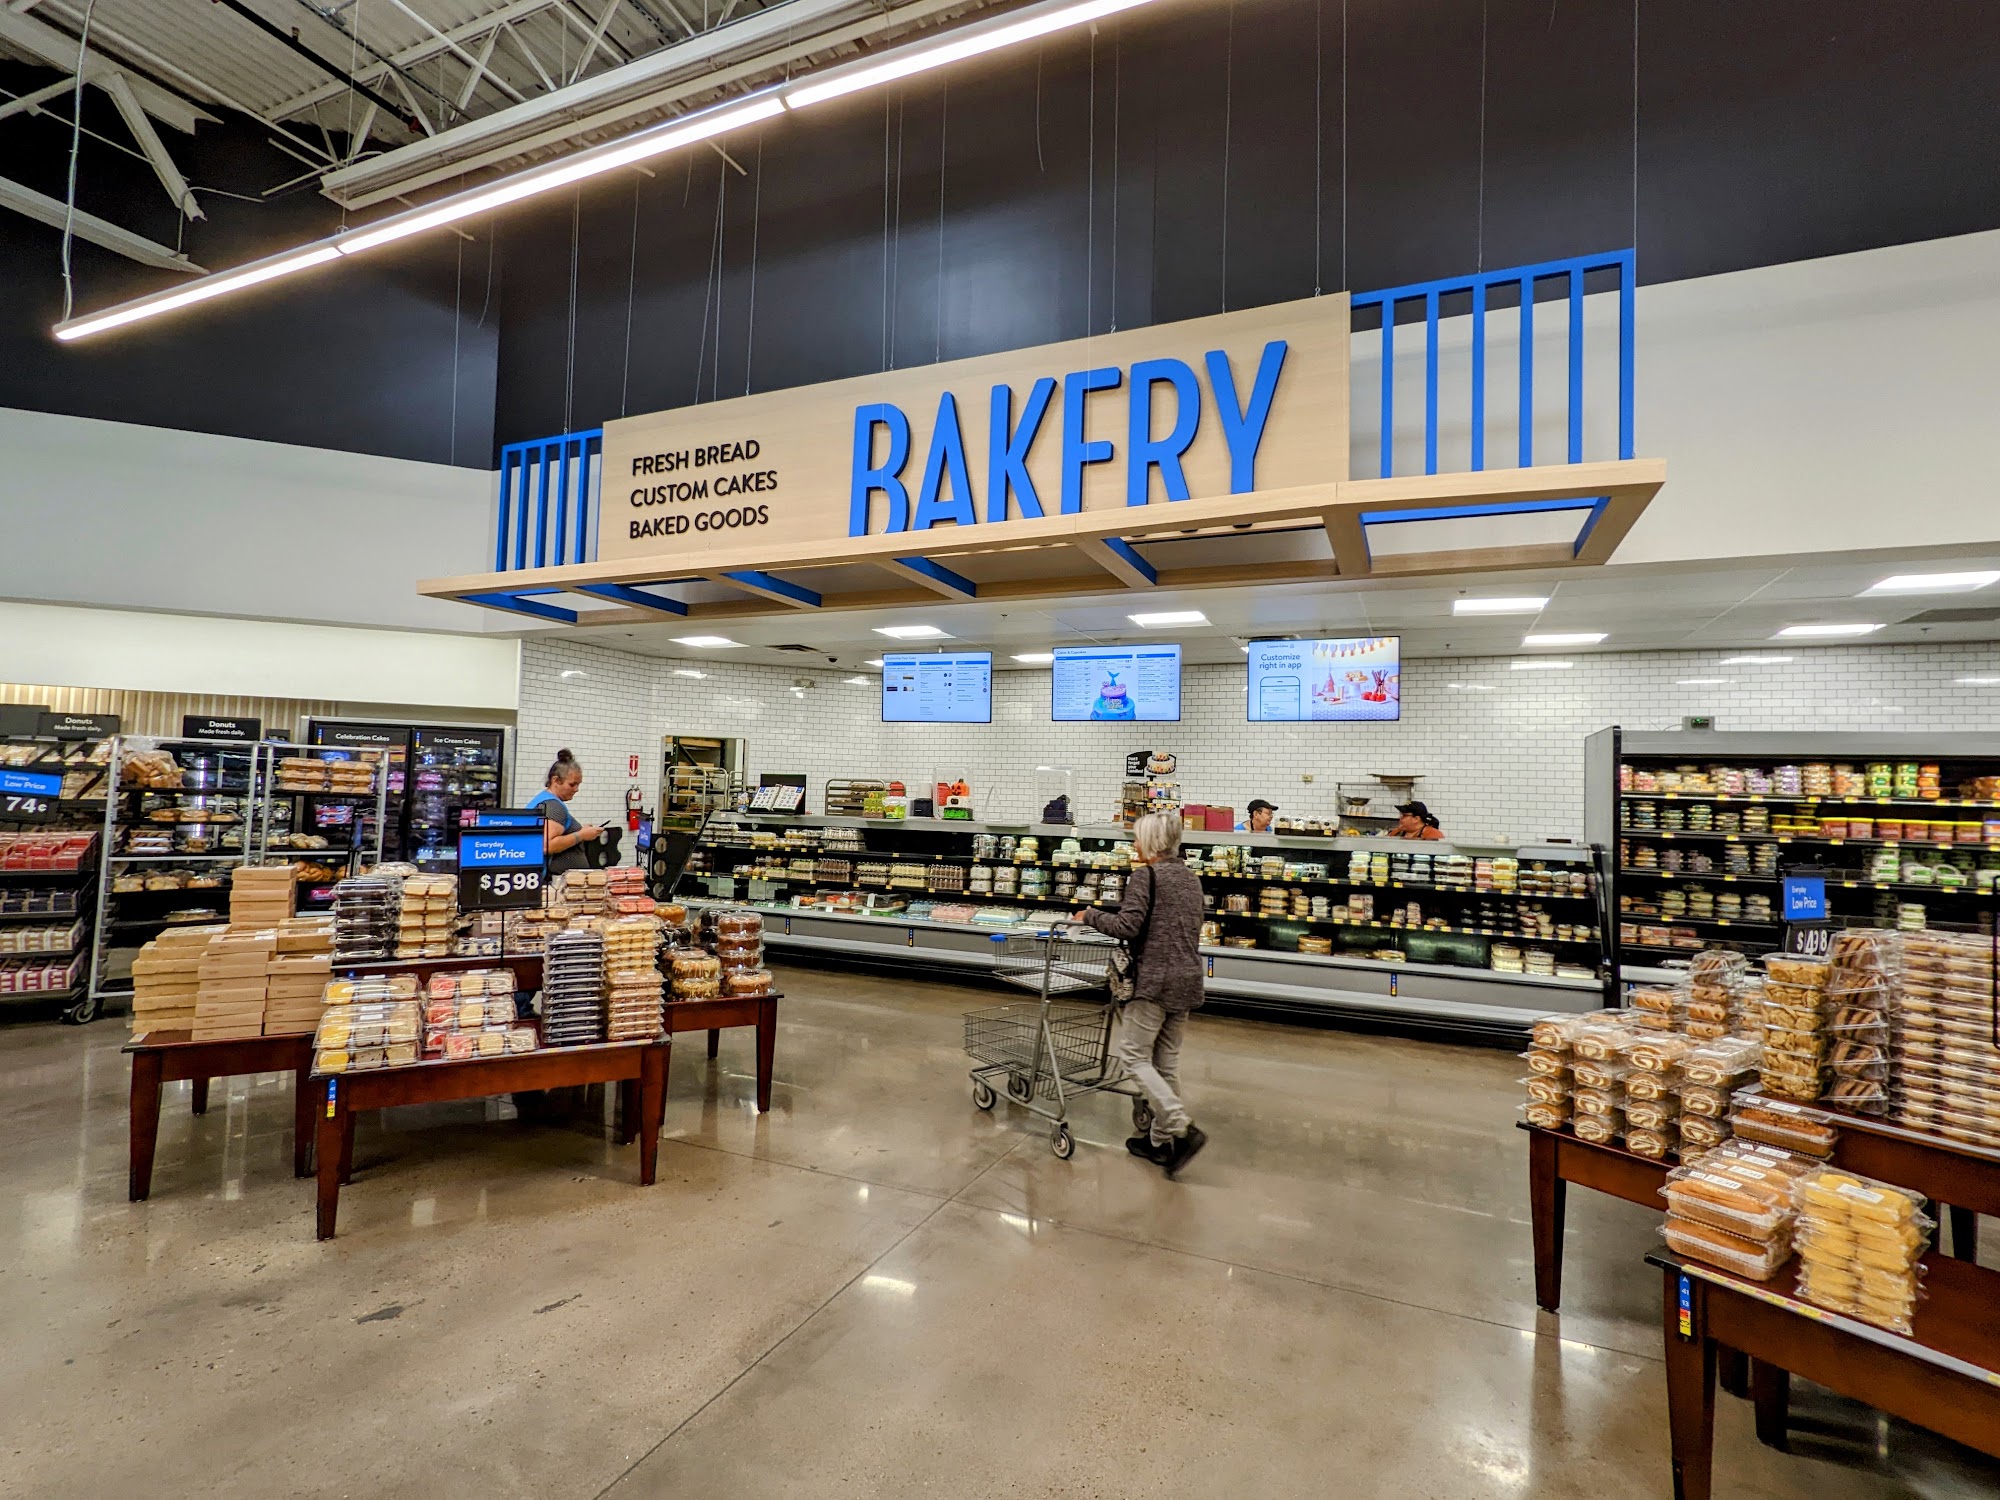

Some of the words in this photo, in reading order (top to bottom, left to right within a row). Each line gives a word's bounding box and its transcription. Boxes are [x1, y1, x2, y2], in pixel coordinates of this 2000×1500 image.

[632, 450, 689, 477] FRESH
[694, 439, 761, 467] BREAD
[630, 479, 709, 508] CUSTOM
[713, 470, 778, 497] CAKES
[629, 514, 690, 540] BAKED
[694, 504, 769, 532] GOODS
[1260, 653, 1301, 661] Customize
[1259, 661, 1277, 670] right
[1279, 661, 1286, 669] in
[1287, 662, 1302, 670] app
[65, 717, 93, 725] Donuts
[208, 720, 236, 729] Donuts
[335, 733, 372, 741] Celebration
[372, 734, 390, 742] Cakes
[433, 736, 442, 744] Ice
[443, 737, 463, 745] Cream
[23, 781, 46, 790] Price
[474, 841, 504, 849] Everyday
[475, 850, 496, 859] Low
[499, 849, 526, 859] Price
[1791, 885, 1807, 895] Everyday
[1792, 897, 1803, 909] Low
[1803, 896, 1817, 909] Price
